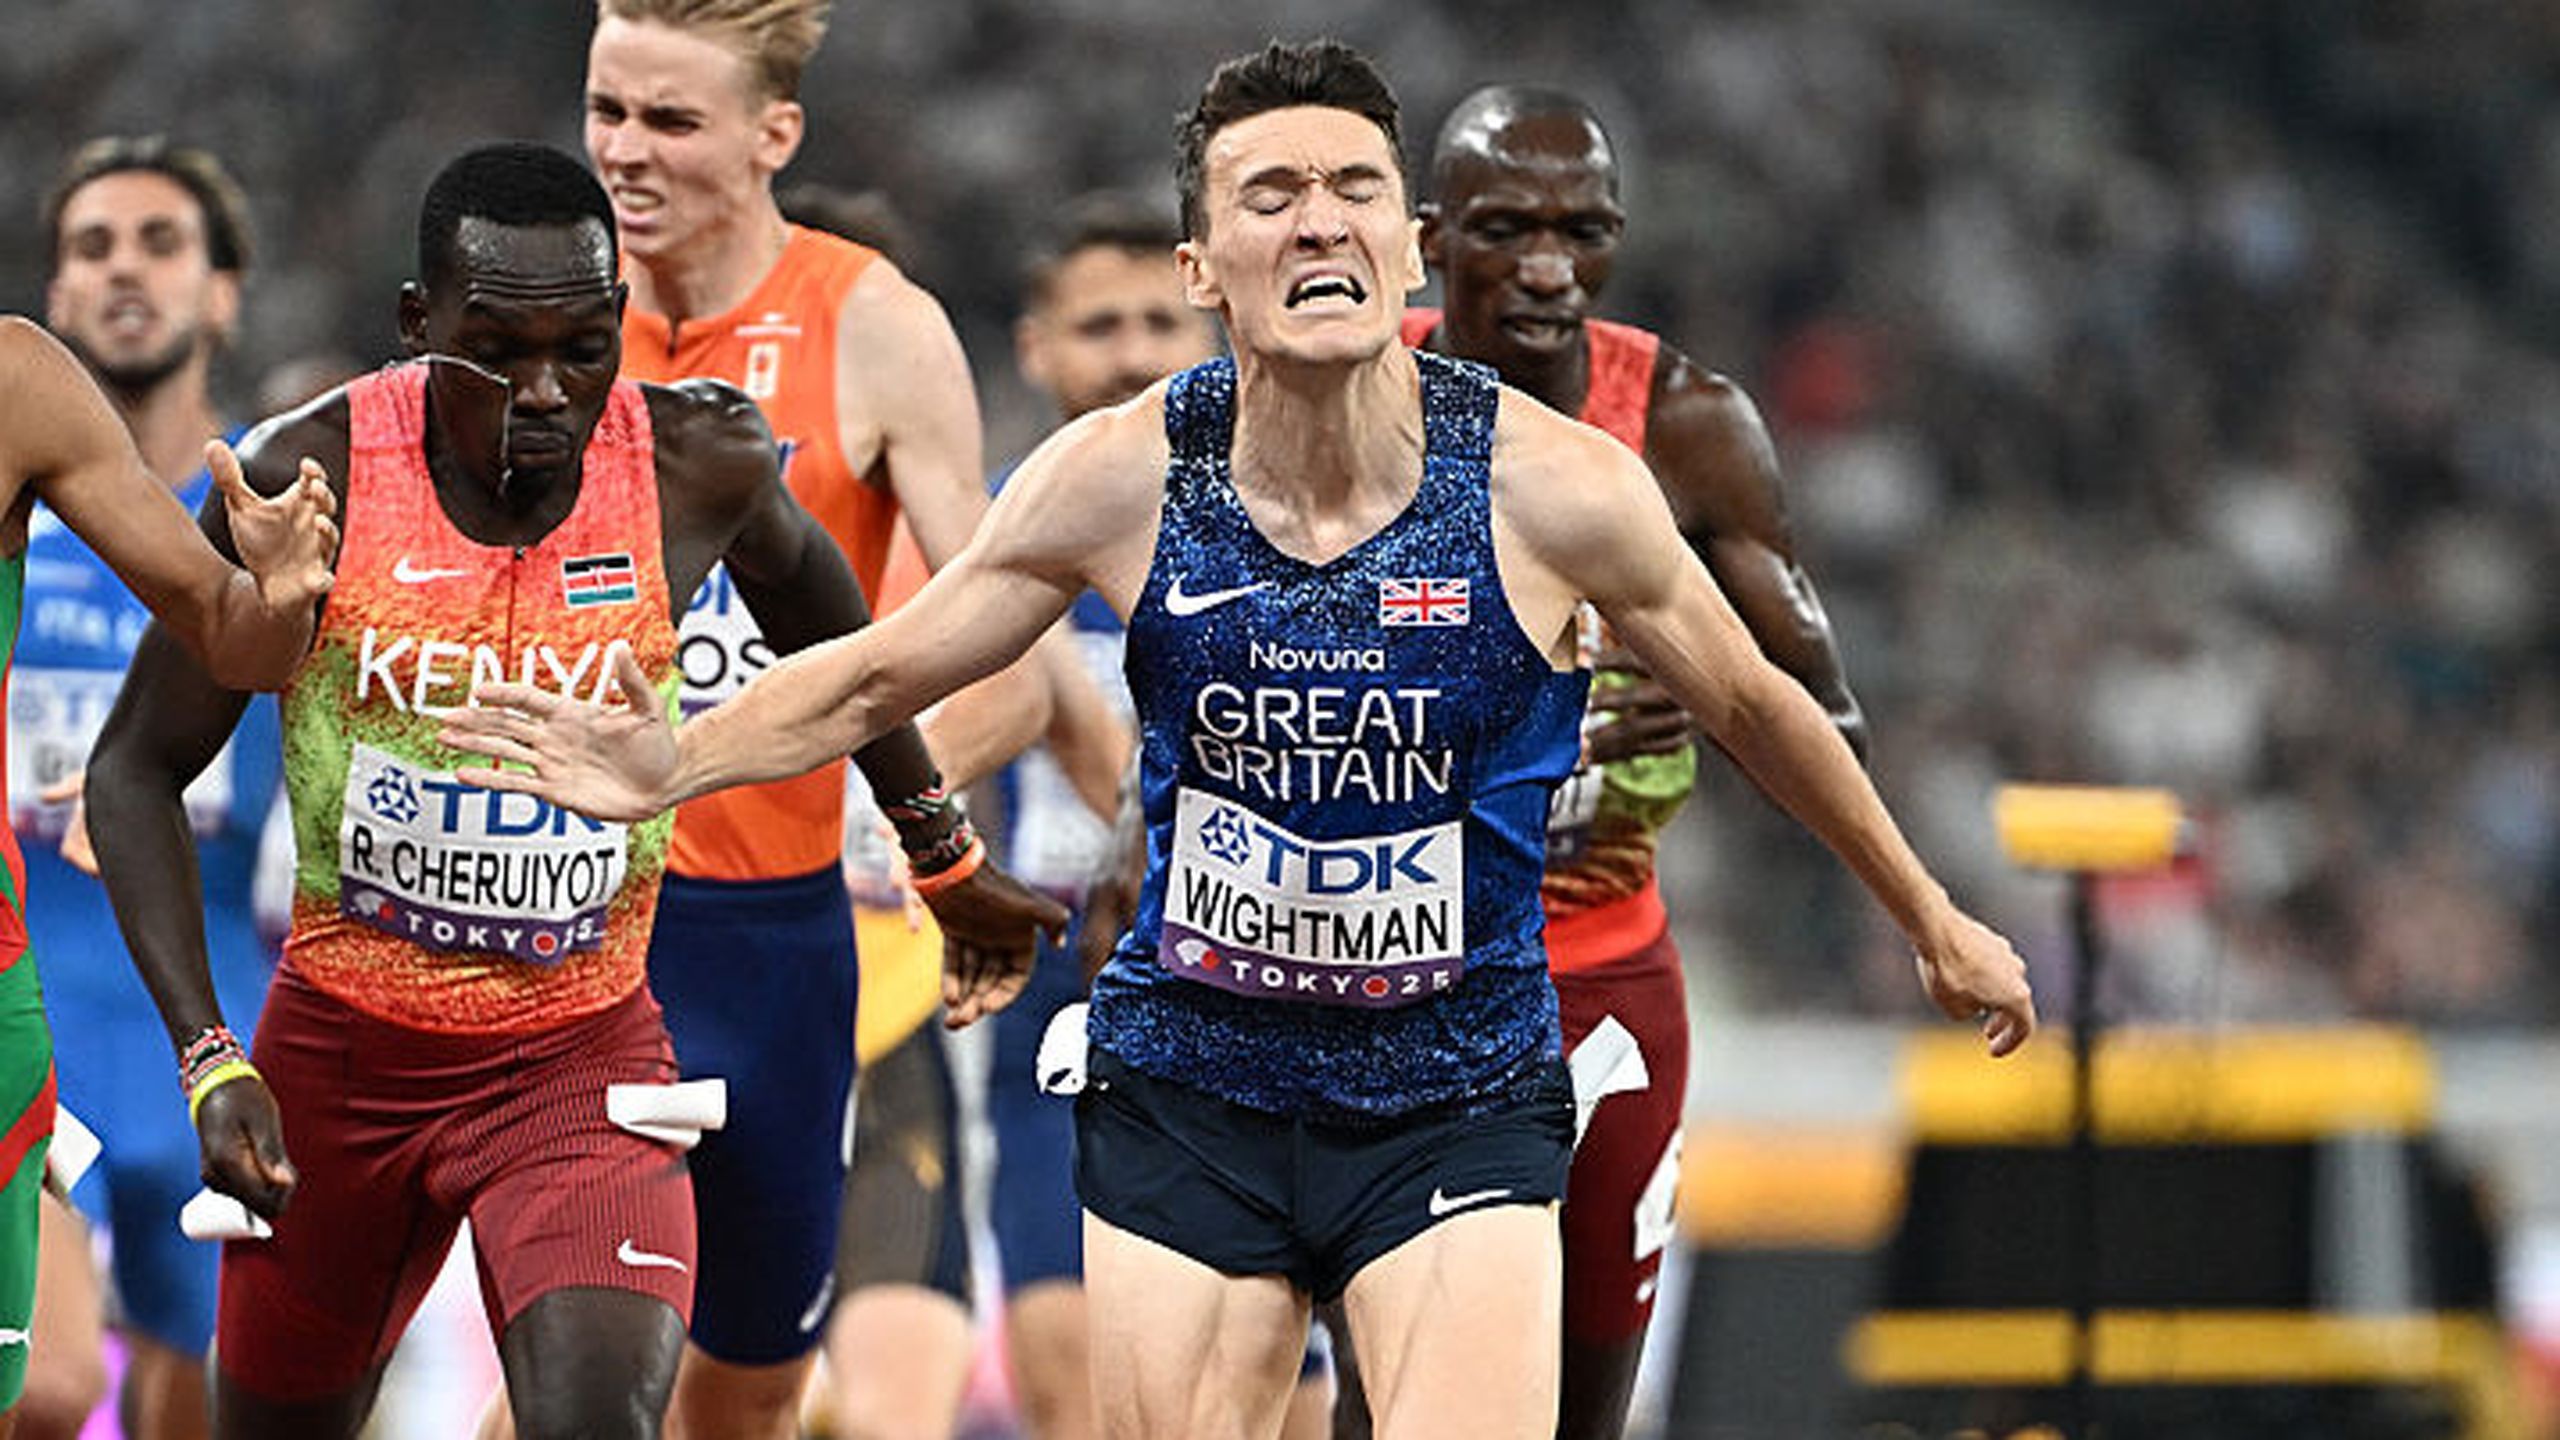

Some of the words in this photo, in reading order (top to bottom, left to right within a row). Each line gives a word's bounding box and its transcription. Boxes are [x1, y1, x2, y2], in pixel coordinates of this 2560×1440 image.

[1249, 641, 1385, 672] Novuna
[1197, 683, 1442, 746] GREAT
[1190, 734, 1454, 804] BRITAIN
[353, 826, 383, 878] R.
[393, 839, 616, 911] CHERUIYOT
[1253, 823, 1438, 895] TDK
[1184, 866, 1450, 963] WIGHTMAN
